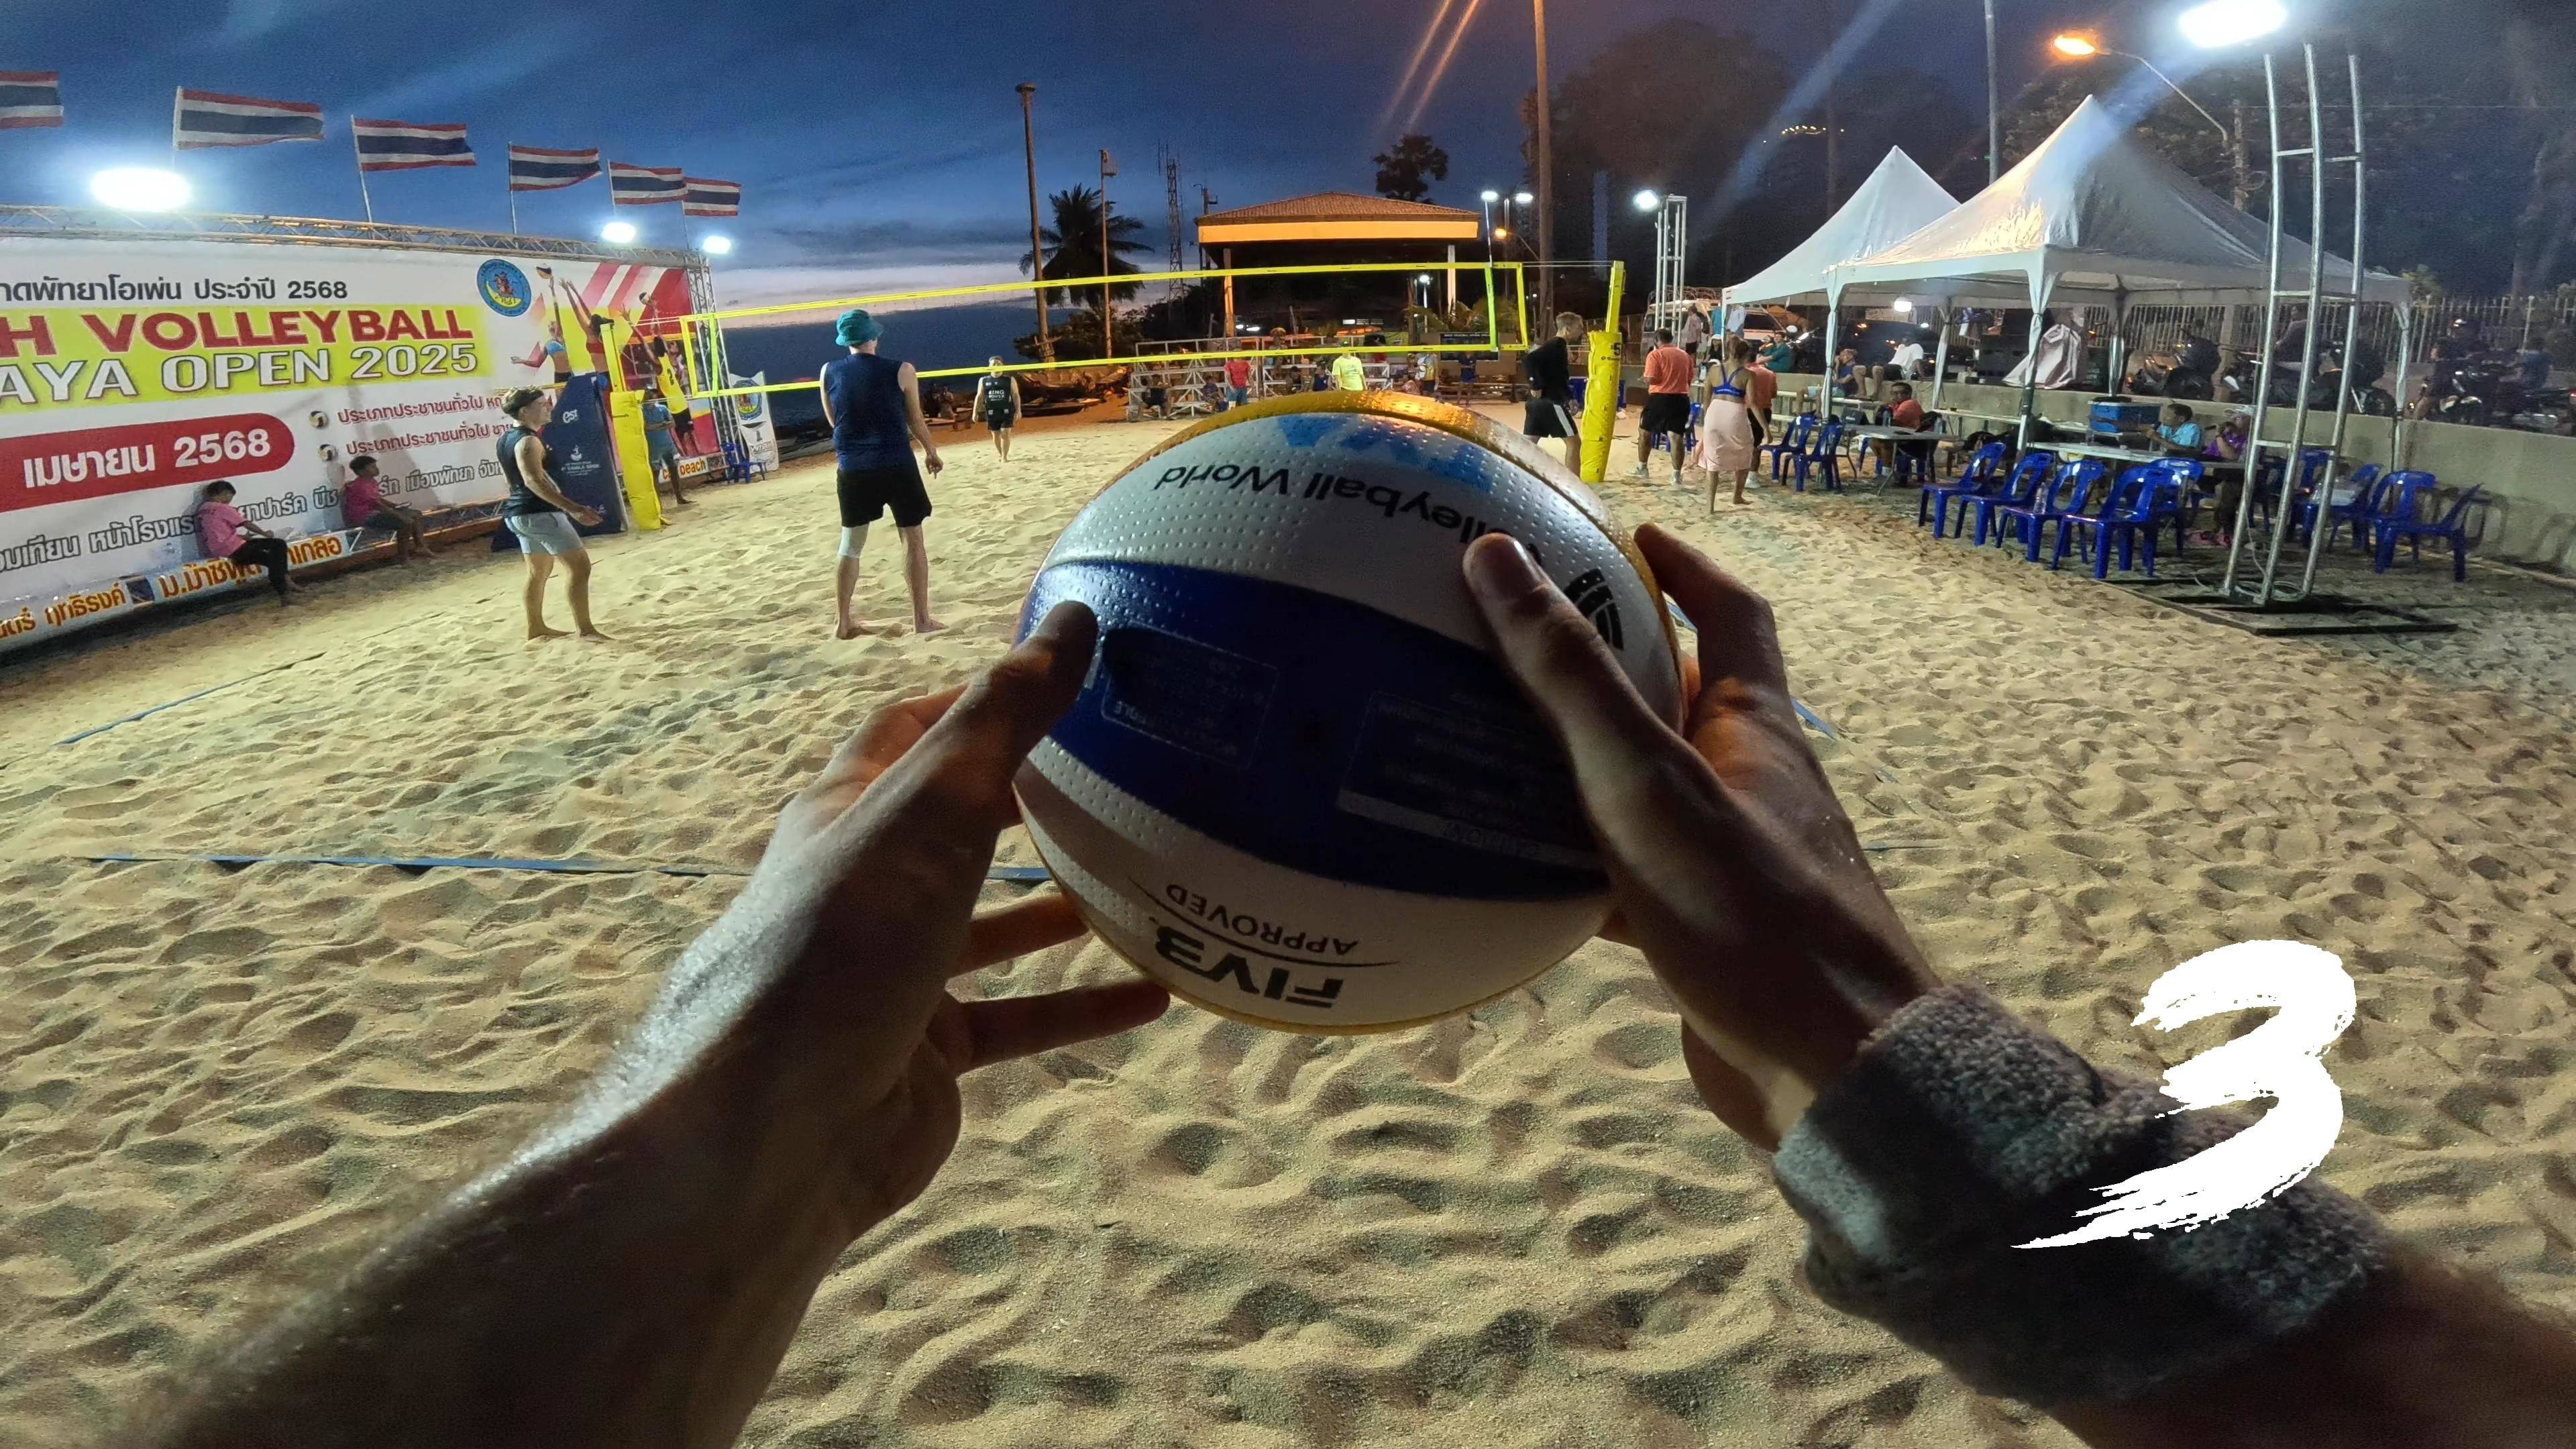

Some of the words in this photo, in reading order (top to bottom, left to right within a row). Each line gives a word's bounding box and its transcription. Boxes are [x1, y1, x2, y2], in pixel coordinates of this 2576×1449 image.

[194, 276, 276, 300] ประจำปี
[287, 280, 348, 299] 2568
[80, 310, 474, 353] VOLLEYBALL
[161, 347, 330, 392] OPEN
[350, 343, 478, 380] 2025
[23, 444, 156, 488] เมษายน
[173, 428, 271, 468] 2568
[1154, 464, 1288, 495] World
[1167, 883, 1358, 955] APPROVED
